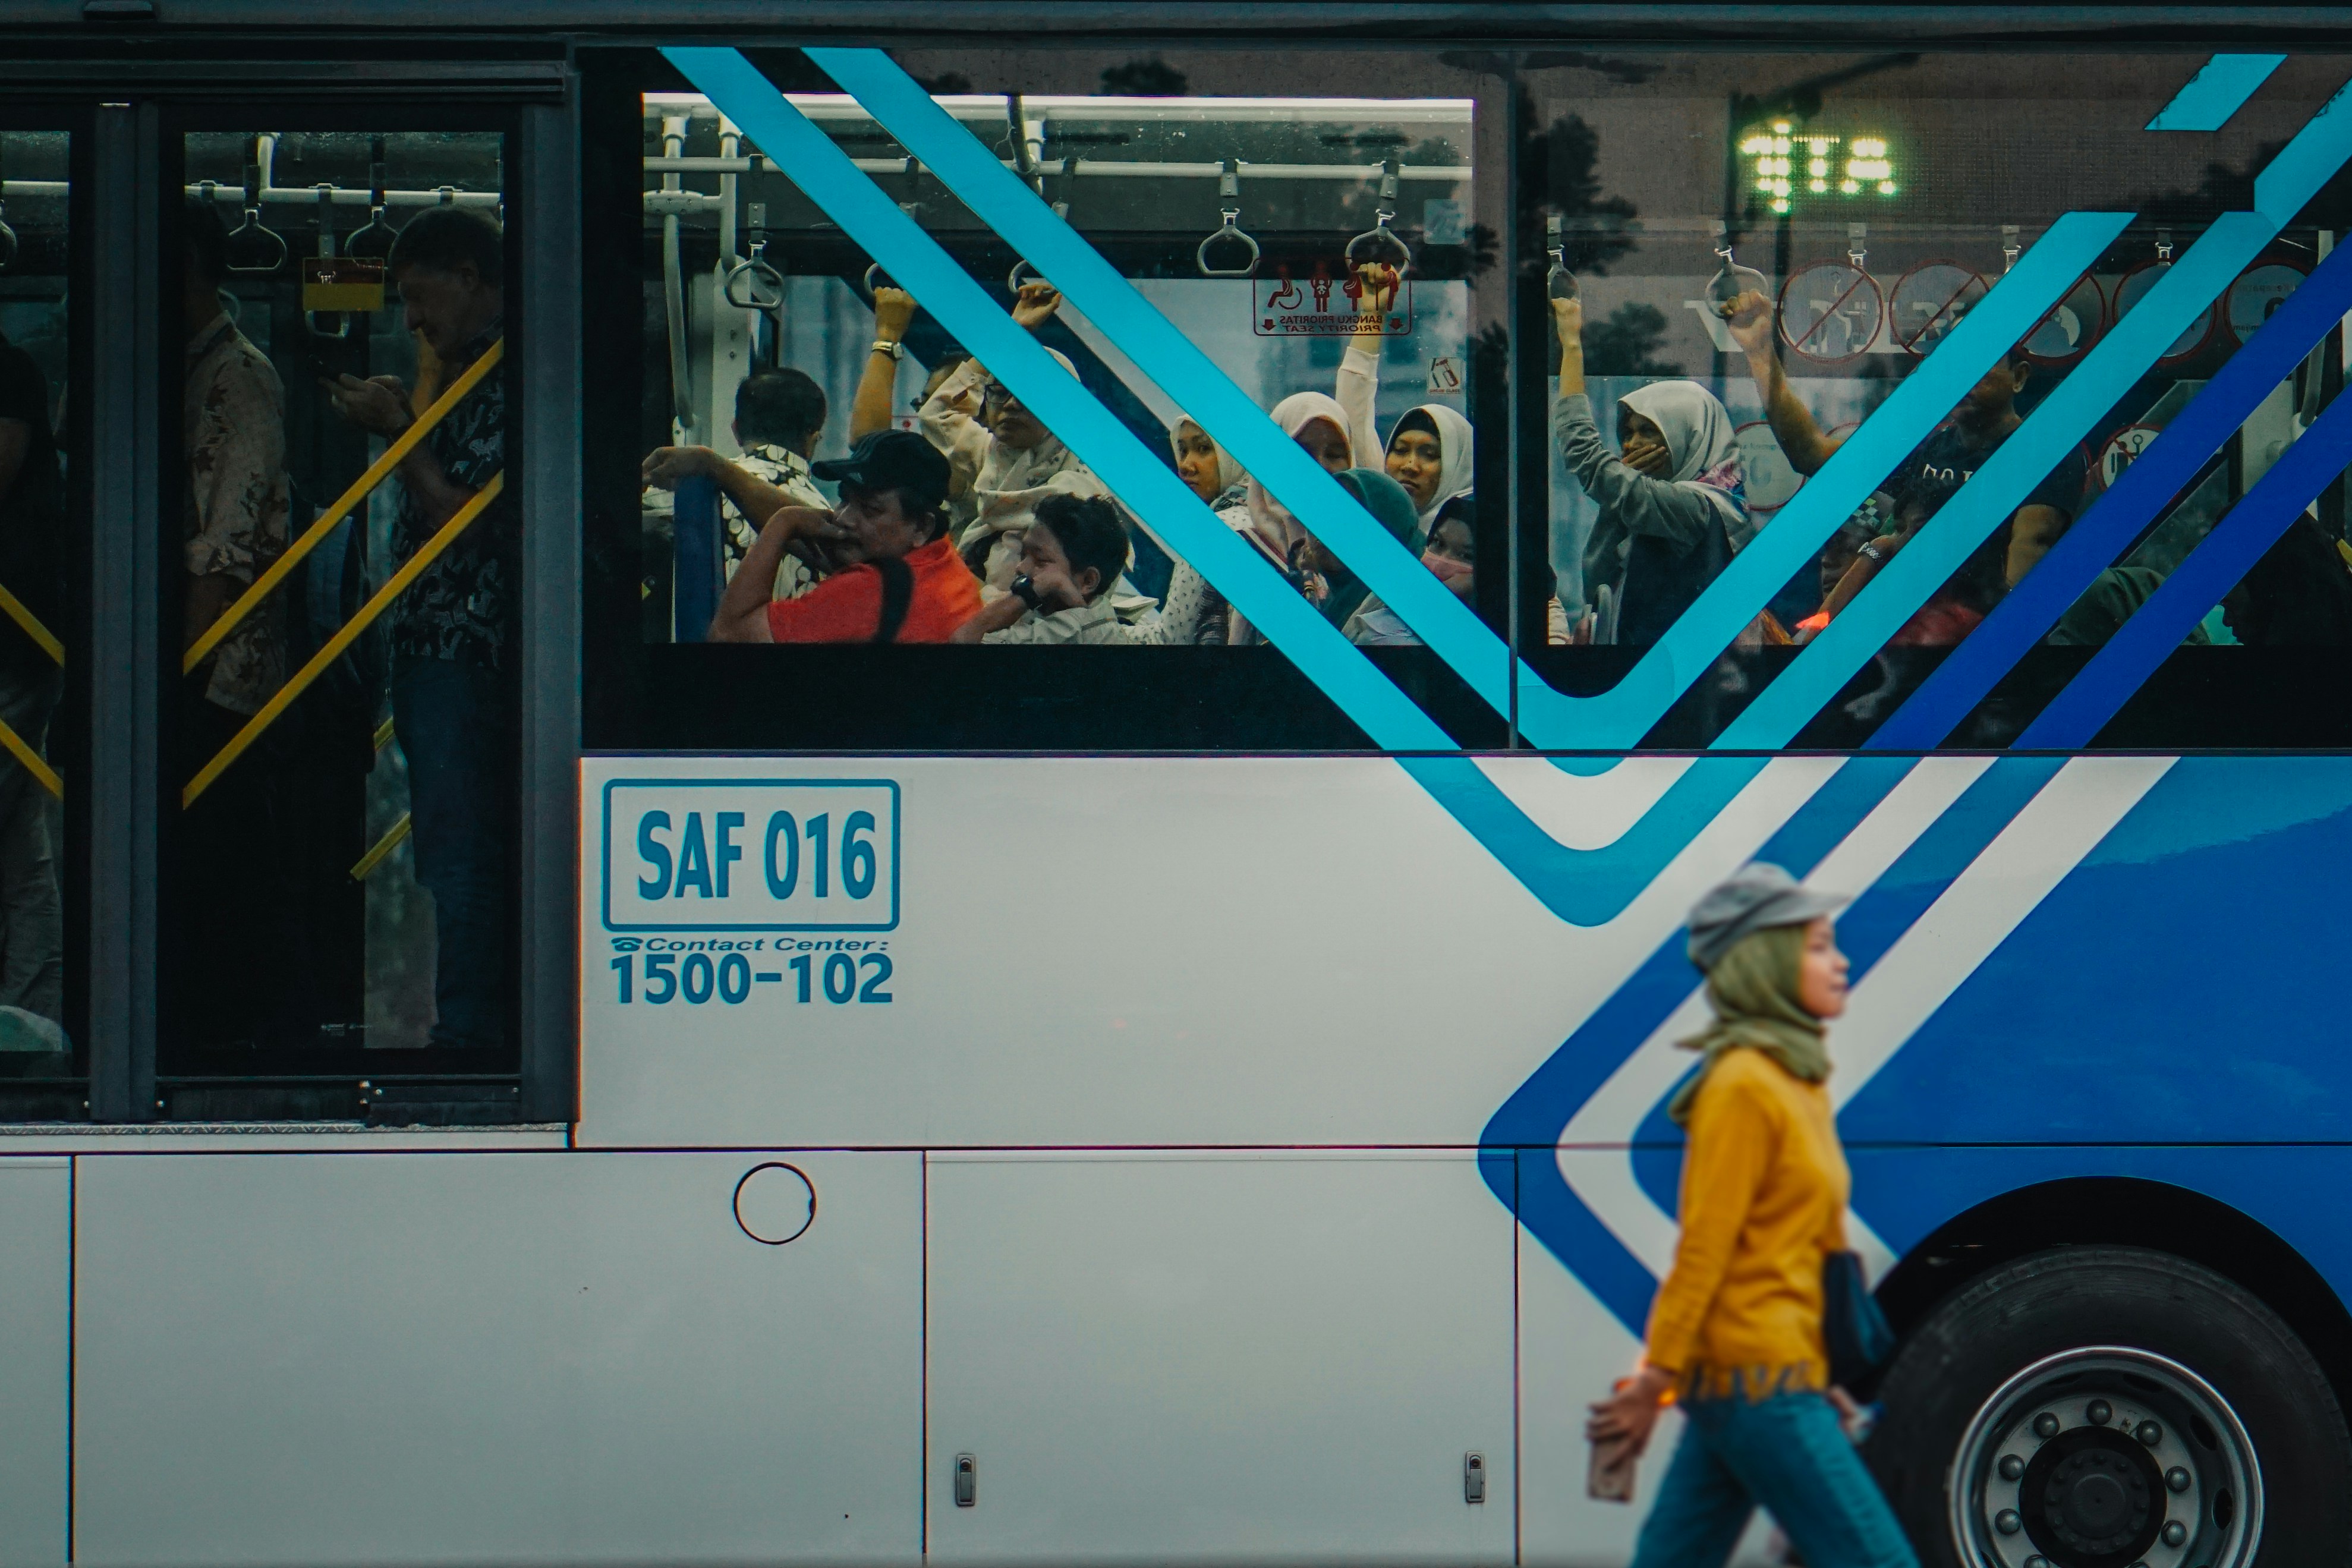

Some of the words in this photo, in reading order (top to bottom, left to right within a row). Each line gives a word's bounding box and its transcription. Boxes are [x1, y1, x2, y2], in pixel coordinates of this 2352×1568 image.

[637, 810, 745, 900] SAF
[764, 810, 876, 899] 016
[646, 937, 765, 951] Contact
[610, 953, 893, 1004] 1500-102
